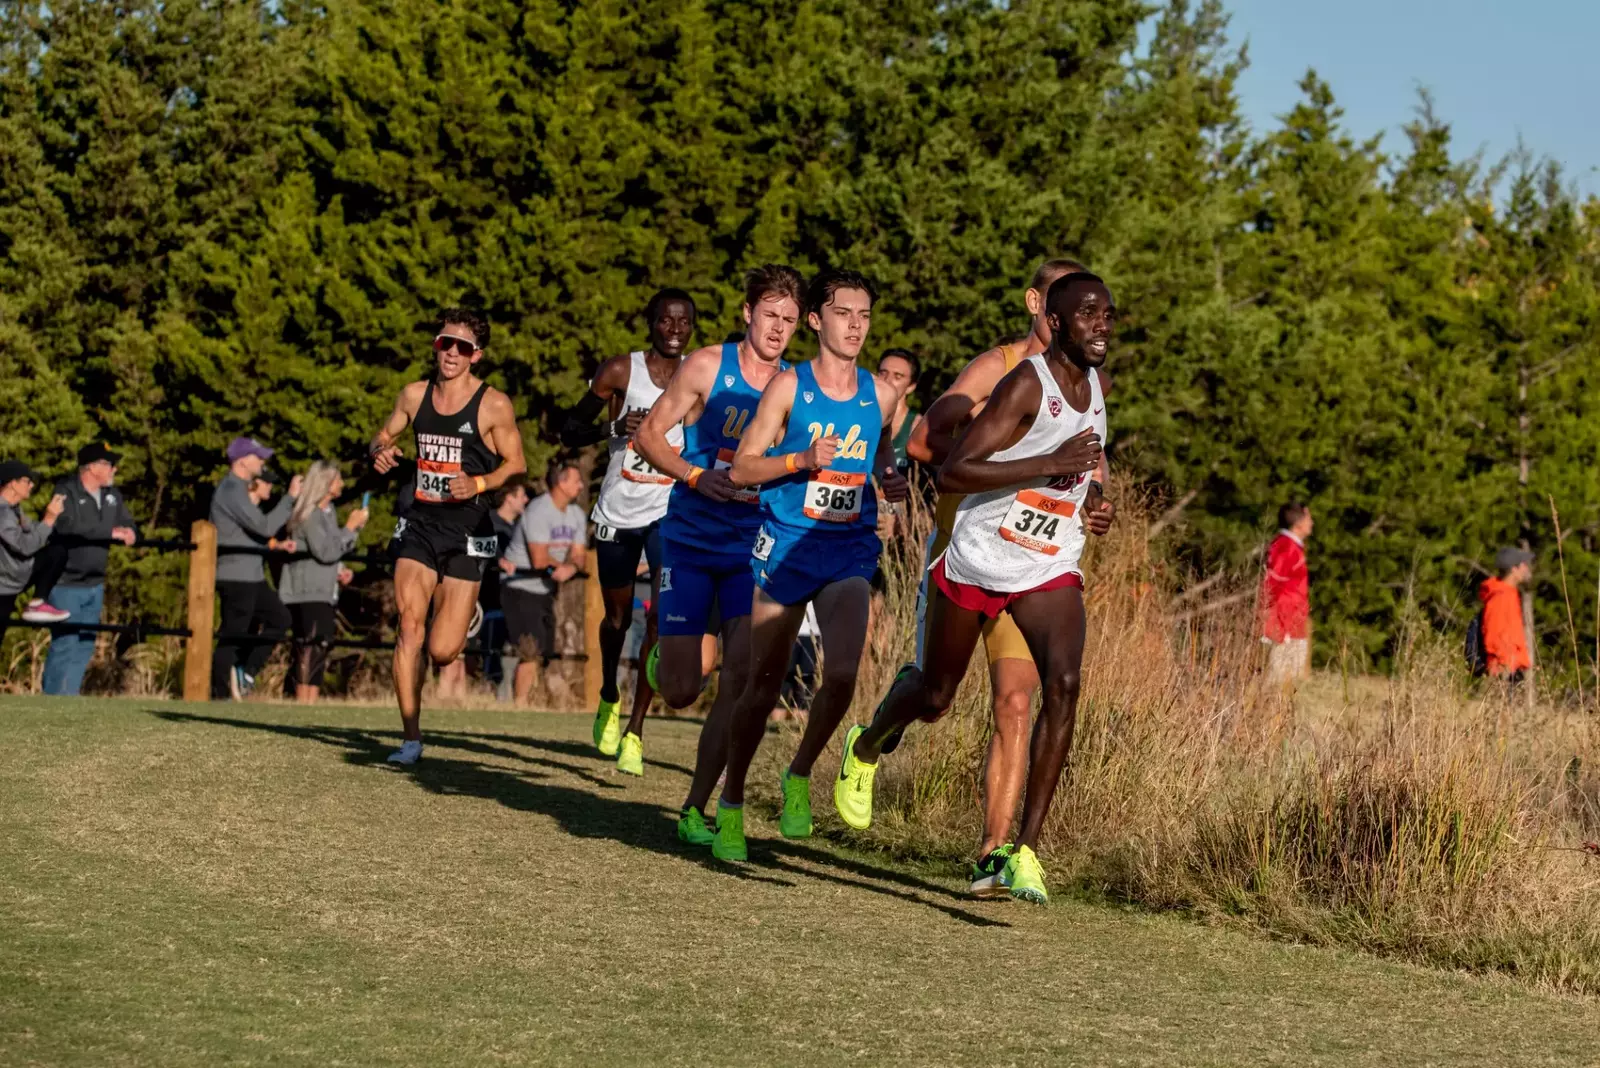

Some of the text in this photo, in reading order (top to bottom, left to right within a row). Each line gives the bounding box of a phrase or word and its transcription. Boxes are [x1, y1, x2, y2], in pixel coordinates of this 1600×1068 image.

[418, 443, 462, 463] UTAH
[815, 486, 856, 511] 363
[1015, 509, 1060, 541] 374
